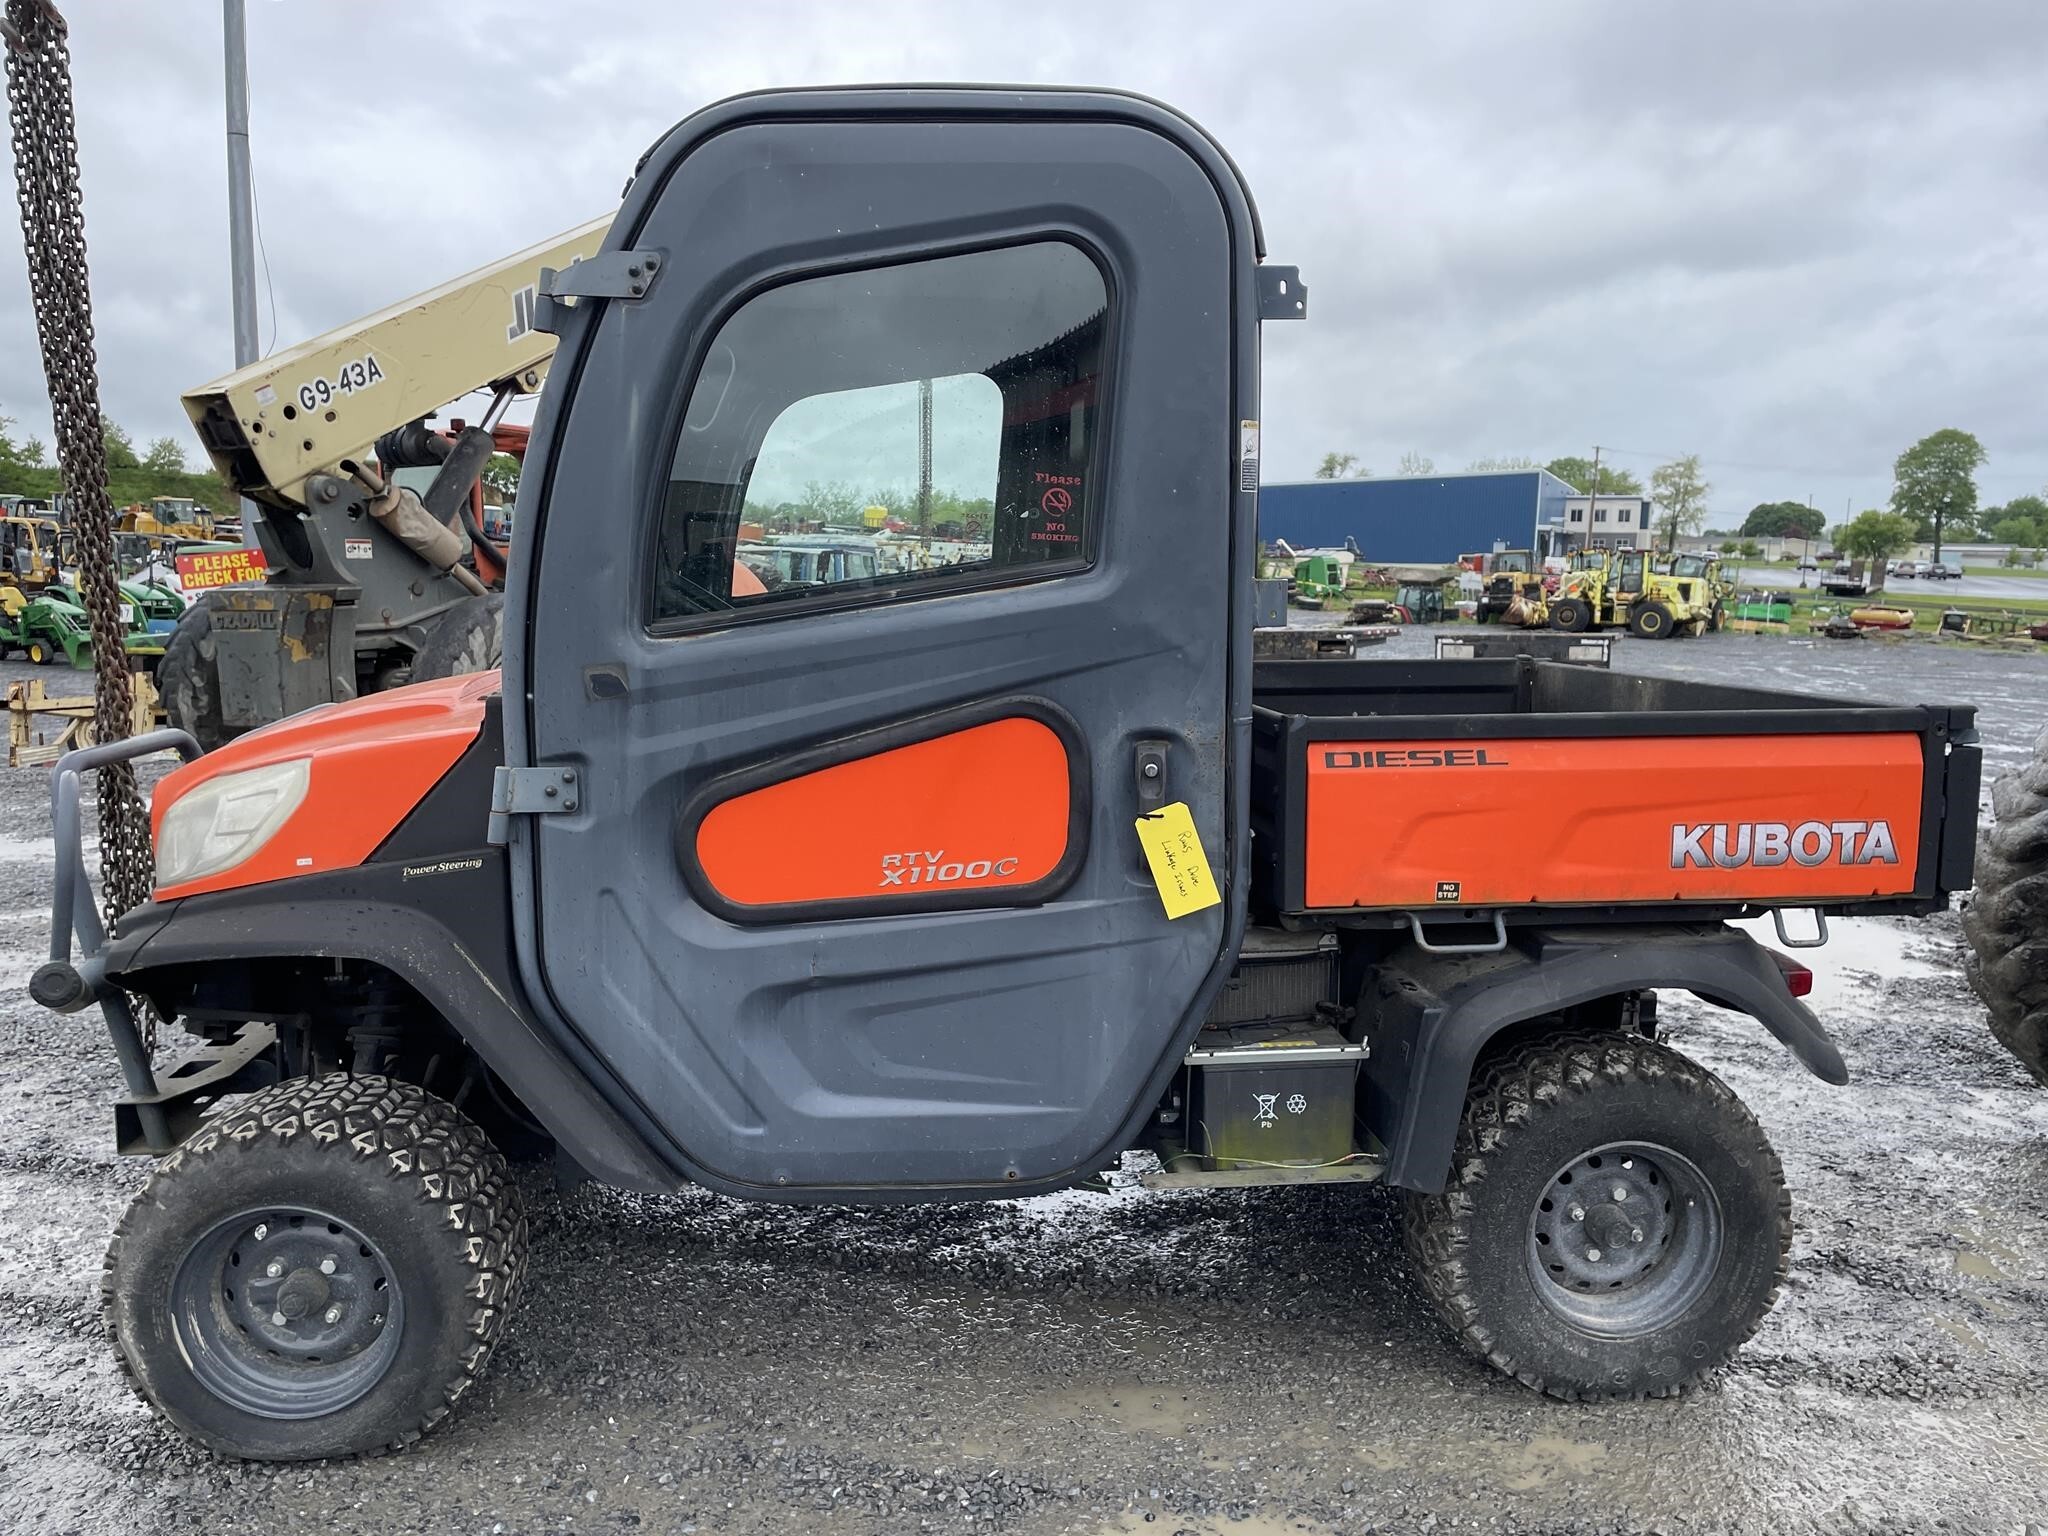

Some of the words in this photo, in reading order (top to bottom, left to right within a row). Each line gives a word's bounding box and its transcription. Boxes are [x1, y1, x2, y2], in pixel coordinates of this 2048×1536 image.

[299, 356, 383, 410] G9-43A
[1035, 472, 1081, 486] Please
[1031, 532, 1079, 542] SMOKING
[1046, 522, 1065, 532] NO
[193, 552, 250, 572] PLEASE
[183, 568, 234, 588] CHECK
[236, 566, 266, 583] FOR
[1324, 749, 1509, 769] DIESEL
[1670, 820, 1900, 868] KUBOTA
[402, 865, 438, 876] Power
[437, 859, 483, 872] Steering
[881, 850, 945, 868] RTV
[878, 857, 1018, 887] X1100C
